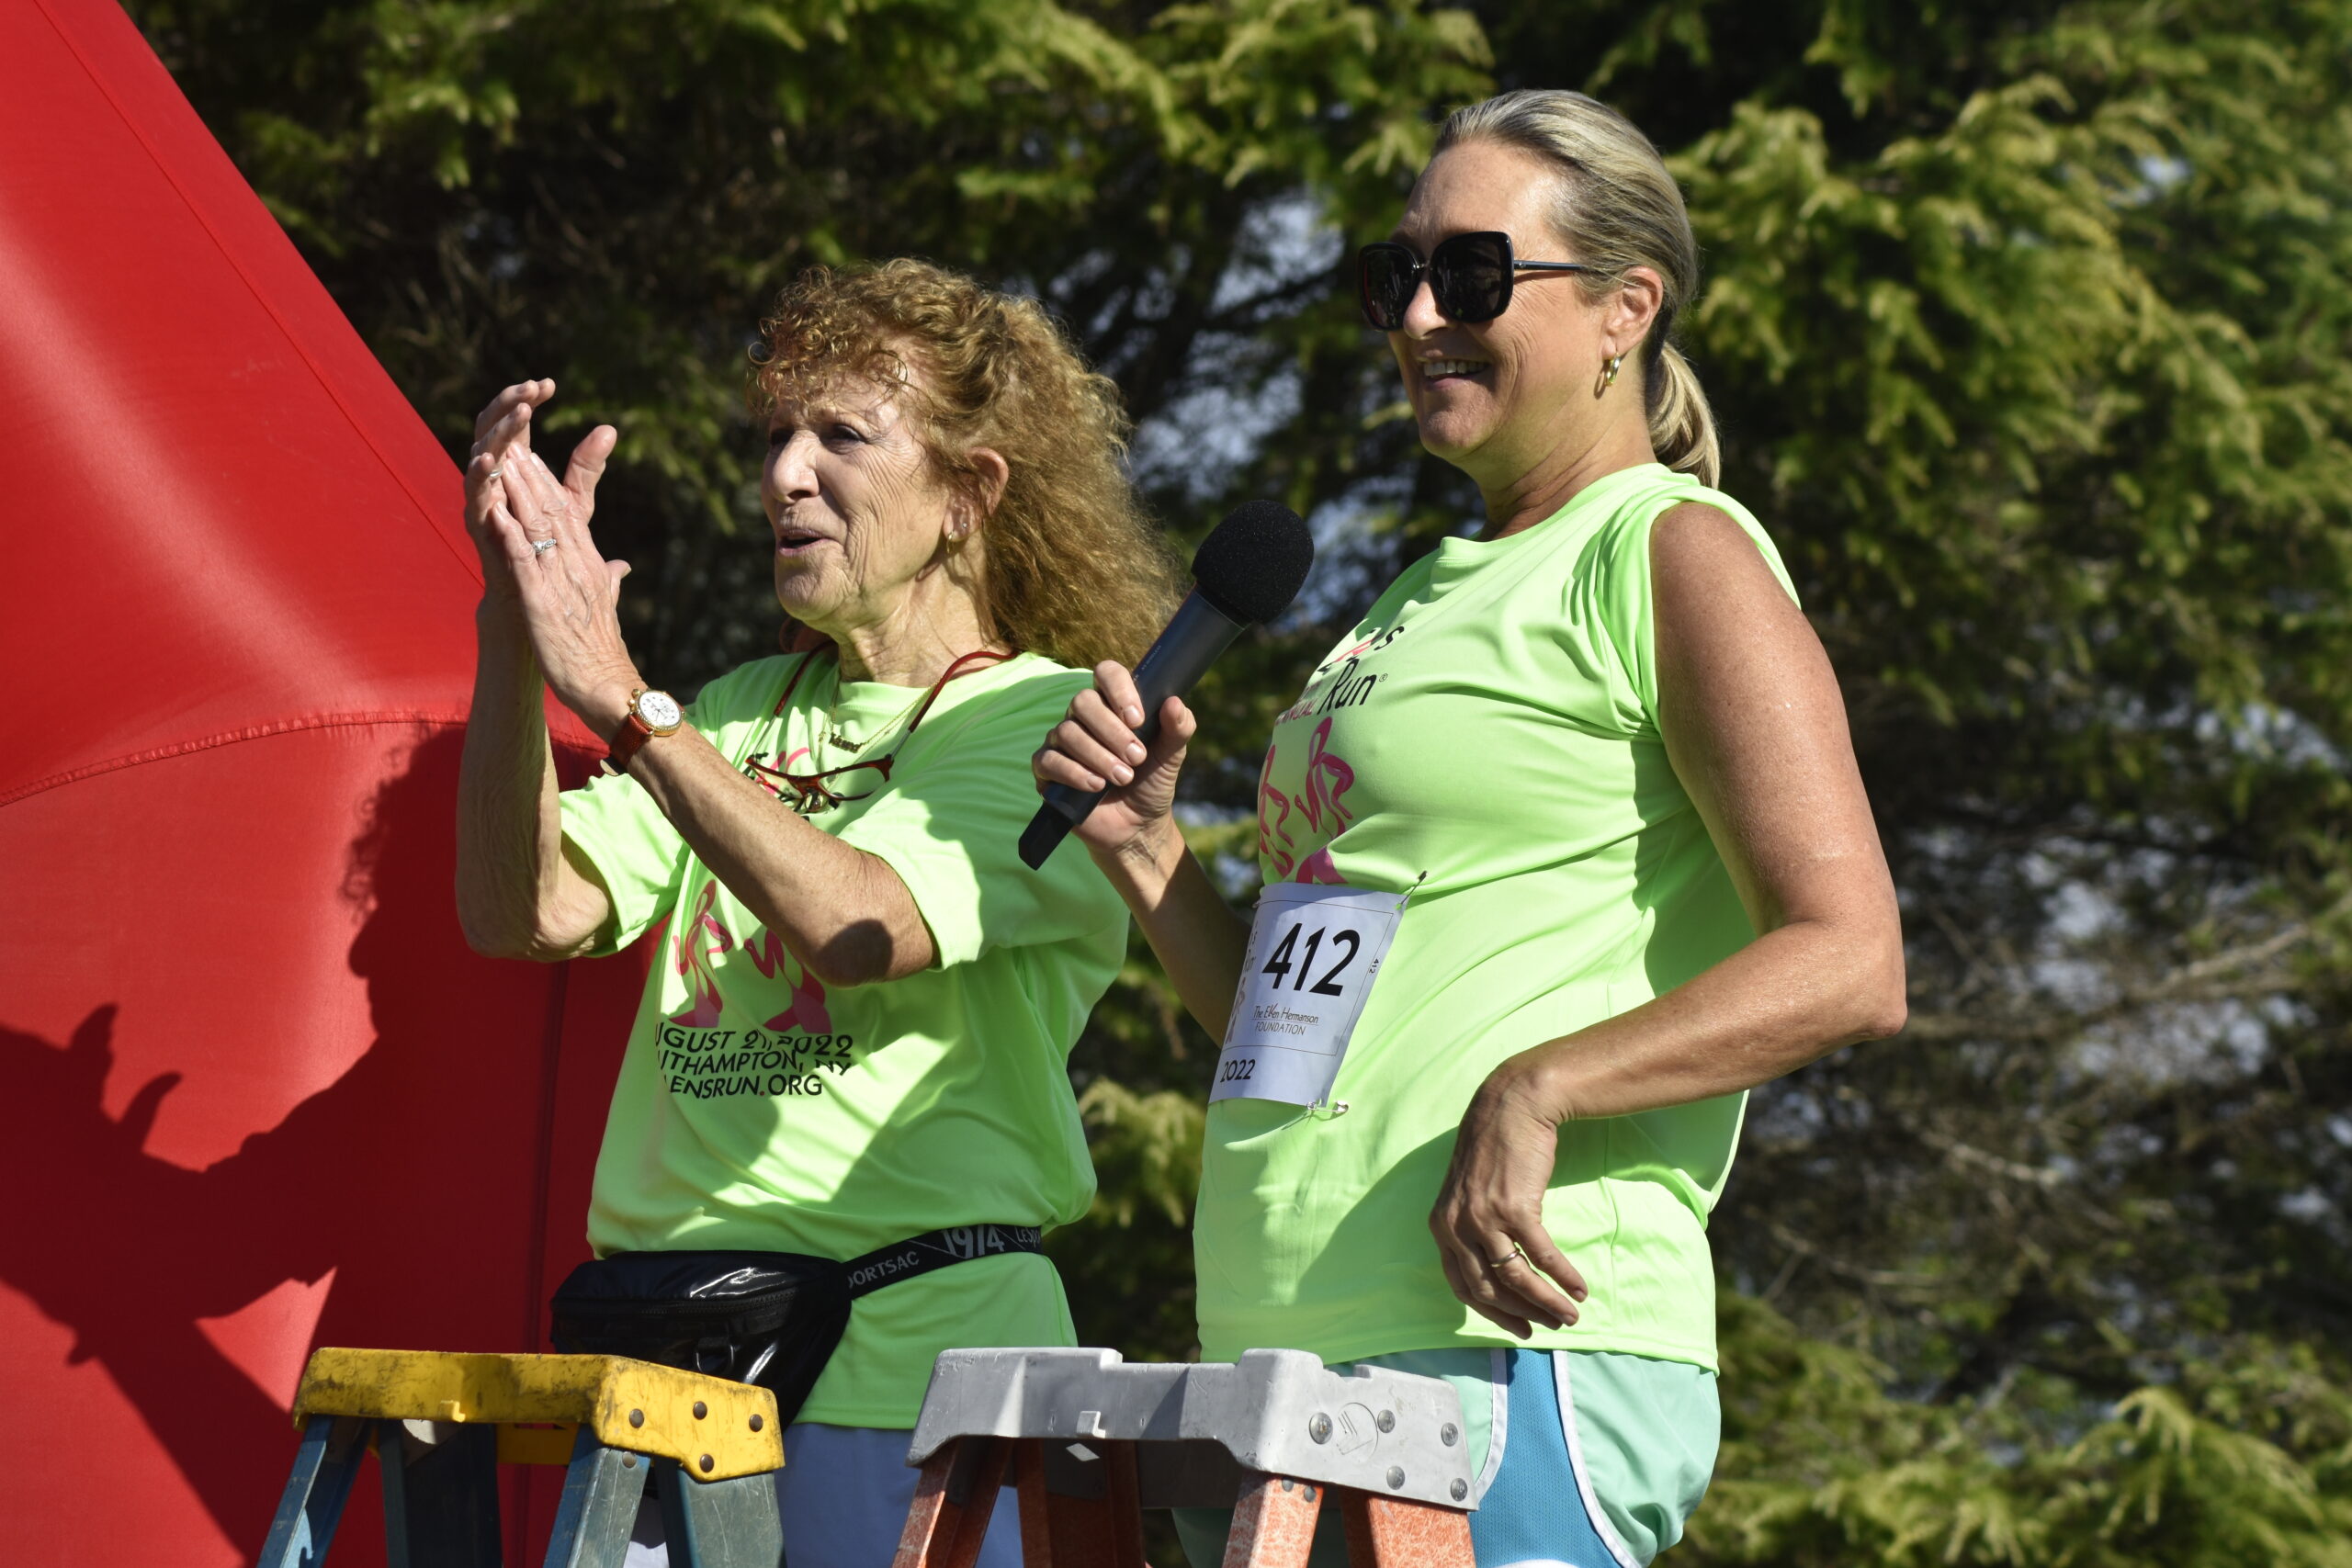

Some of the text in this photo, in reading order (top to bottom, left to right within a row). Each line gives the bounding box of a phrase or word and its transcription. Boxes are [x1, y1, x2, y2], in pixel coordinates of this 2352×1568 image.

[1261, 922, 1361, 997] 412
[1253, 1005, 1264, 1019] The
[1280, 1007, 1319, 1024] Hermanson
[654, 1021, 736, 1054] UGUST
[776, 1033, 854, 1058] 2022
[1255, 1021, 1306, 1036] FOUNDATION
[815, 1058, 853, 1077] NY
[1219, 1058, 1256, 1083] 2022
[663, 1073, 823, 1100] ENSRUN.ORG
[847, 1250, 920, 1290] ORTSAC
